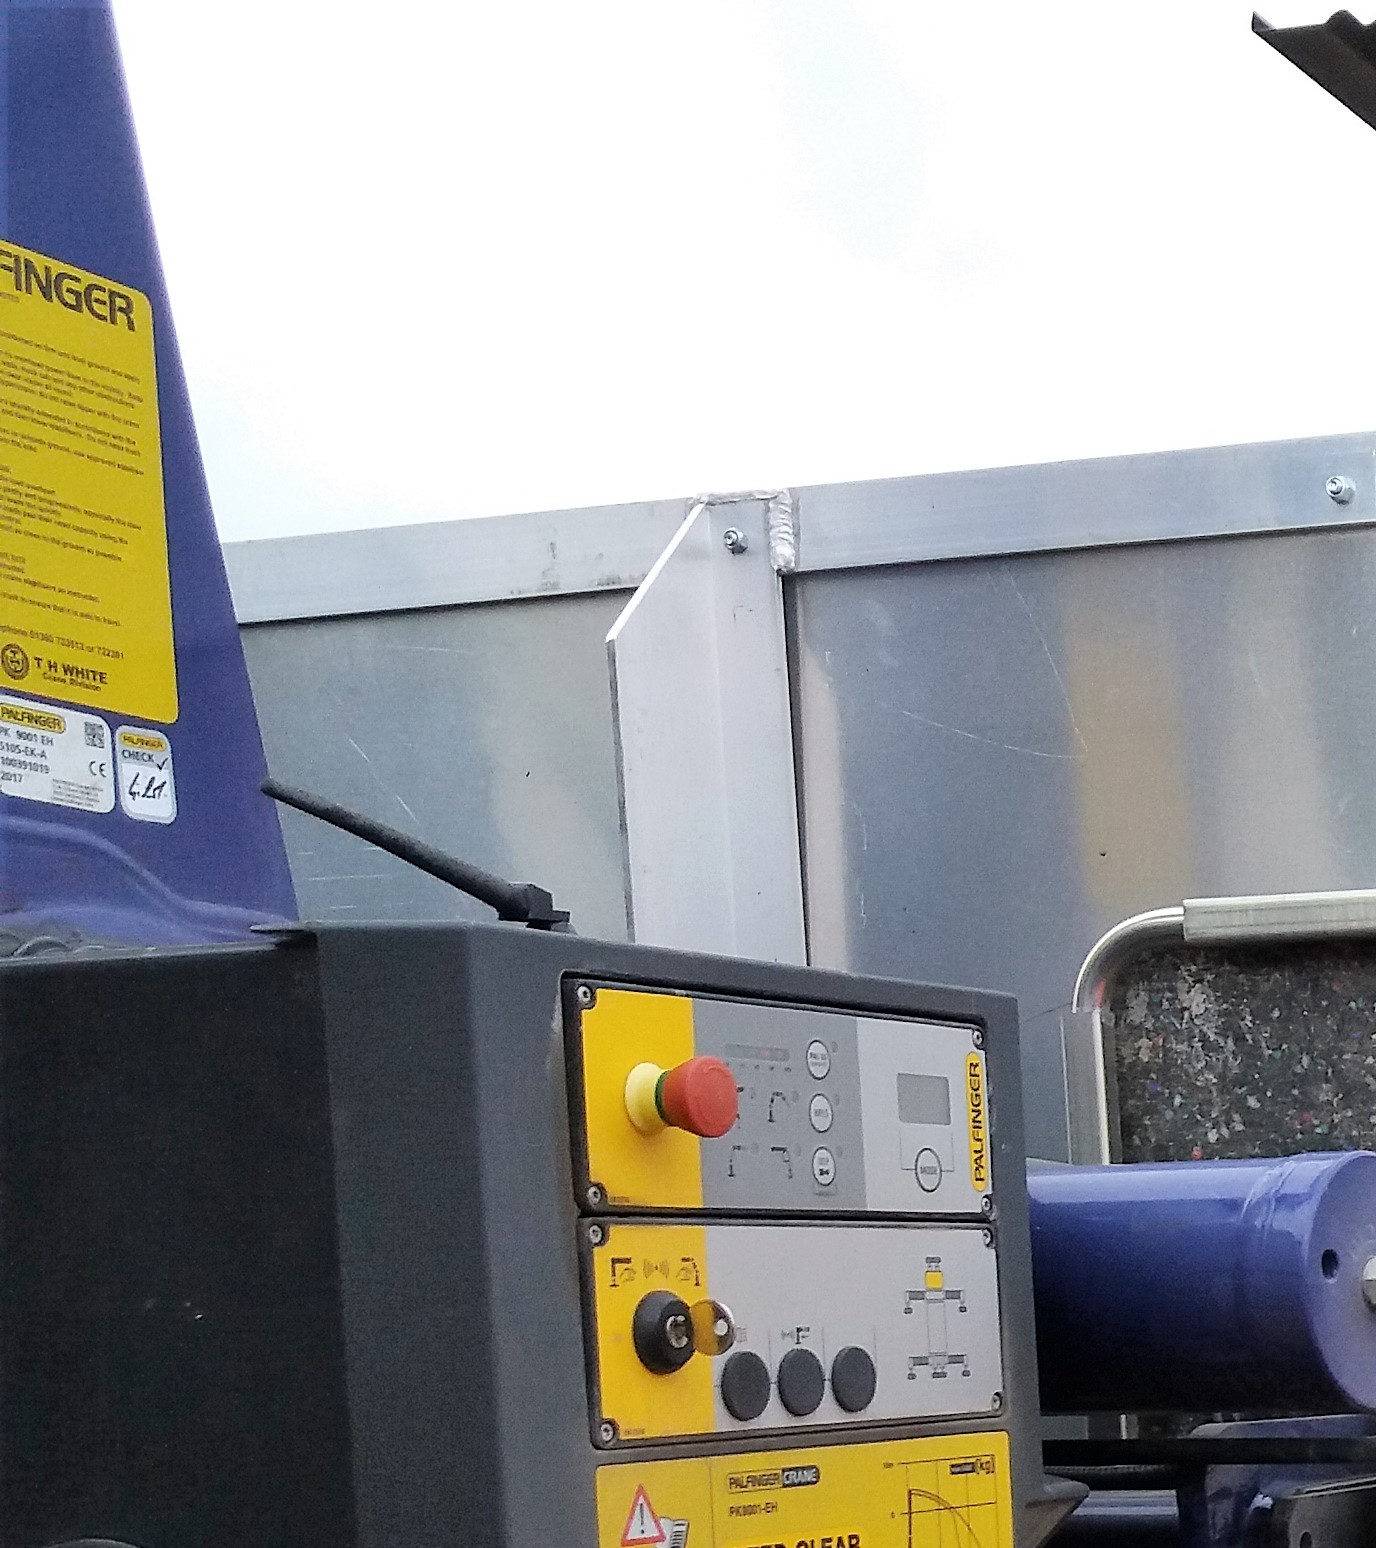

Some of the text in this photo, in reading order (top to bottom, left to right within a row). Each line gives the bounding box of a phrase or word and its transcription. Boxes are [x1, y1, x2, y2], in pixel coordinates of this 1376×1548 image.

[62, 662, 108, 685] WHITE
[1, 705, 61, 730] PALFINGER
[121, 750, 154, 763] CHECK
[968, 1062, 986, 1182] PALFINGER
